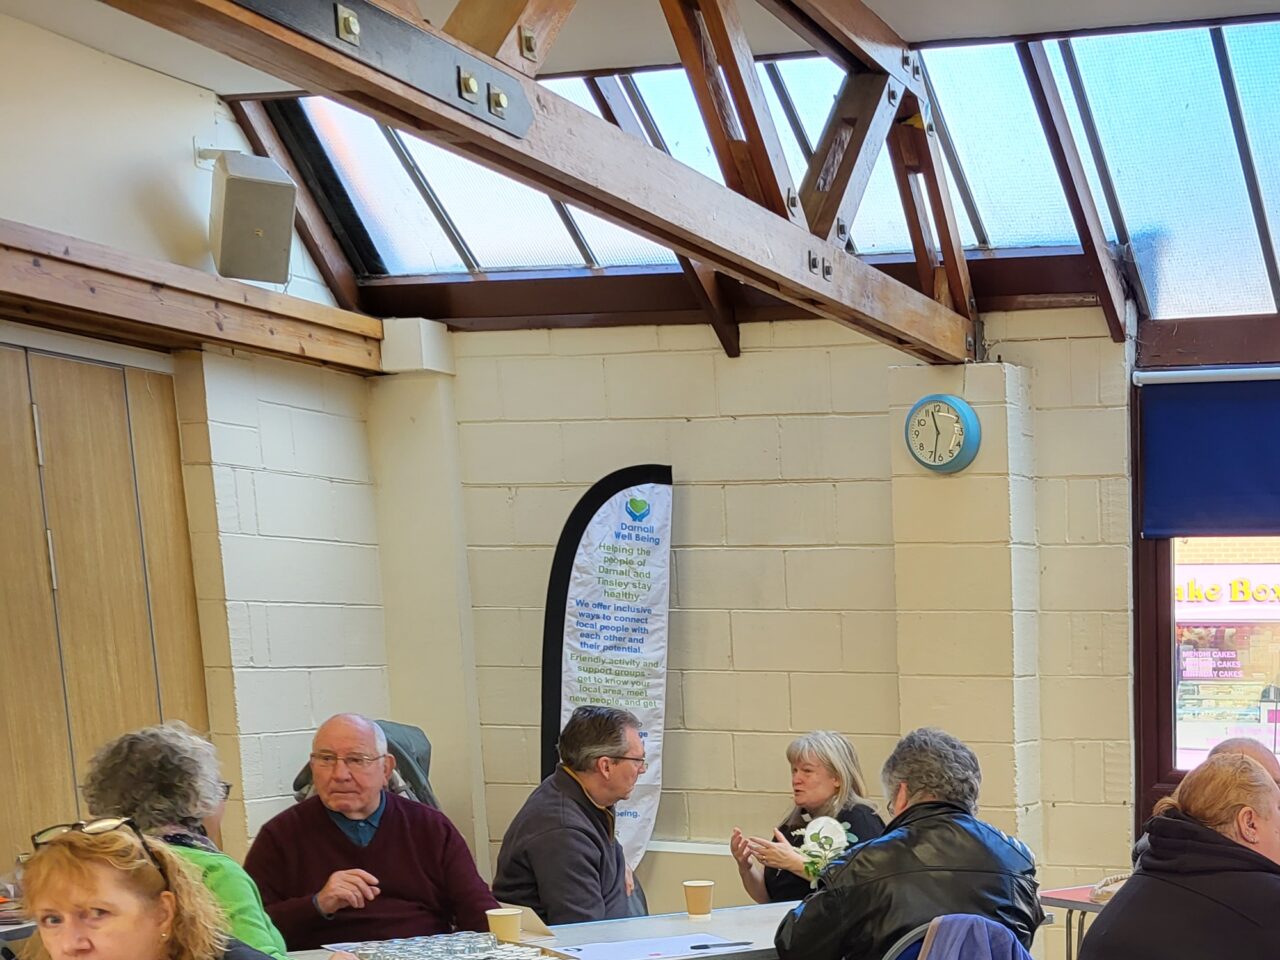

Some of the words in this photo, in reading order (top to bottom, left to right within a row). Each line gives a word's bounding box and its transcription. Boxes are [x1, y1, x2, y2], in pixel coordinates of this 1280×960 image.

[933, 404, 941, 412] 12
[917, 418, 926, 427] 10
[914, 429, 920, 439] 9
[919, 442, 925, 451] 8
[928, 450, 934, 459] 7
[938, 453, 944, 462] 6
[948, 449, 954, 458] 5
[620, 522, 654, 533] Darnall
[614, 531, 632, 541] Well
[635, 534, 660, 545] Being
[598, 542, 634, 556] Helping
[636, 547, 651, 556] the
[603, 556, 634, 566] people
[636, 559, 646, 567] of
[598, 565, 630, 577] Darnall
[633, 570, 651, 579] and
[596, 577, 628, 590] Tinsley
[632, 581, 652, 592] stay
[575, 599, 589, 608] We
[592, 602, 611, 610] offer
[613, 604, 652, 614] inclusive
[578, 611, 600, 621] ways
[602, 613, 612, 621] to
[614, 615, 648, 624] connect
[576, 620, 597, 630] local
[599, 624, 629, 633] people
[631, 627, 649, 635] with
[579, 632, 600, 640] each
[603, 634, 626, 642] other
[580, 641, 601, 650] their
[602, 644, 643, 654] potential.
[570, 653, 606, 665] Friendly
[608, 657, 640, 668] activity
[643, 660, 659, 668] and
[577, 665, 612, 675] support
[614, 669, 645, 678] groups
[577, 675, 591, 684] get
[594, 676, 603, 684] to
[605, 677, 629, 686] know
[631, 680, 650, 688] your
[579, 685, 601, 694] local
[602, 687, 624, 696] area,
[626, 689, 648, 697] meet
[569, 695, 587, 703] new
[590, 697, 622, 706] people,
[624, 699, 640, 707] and
[643, 700, 657, 708] get
